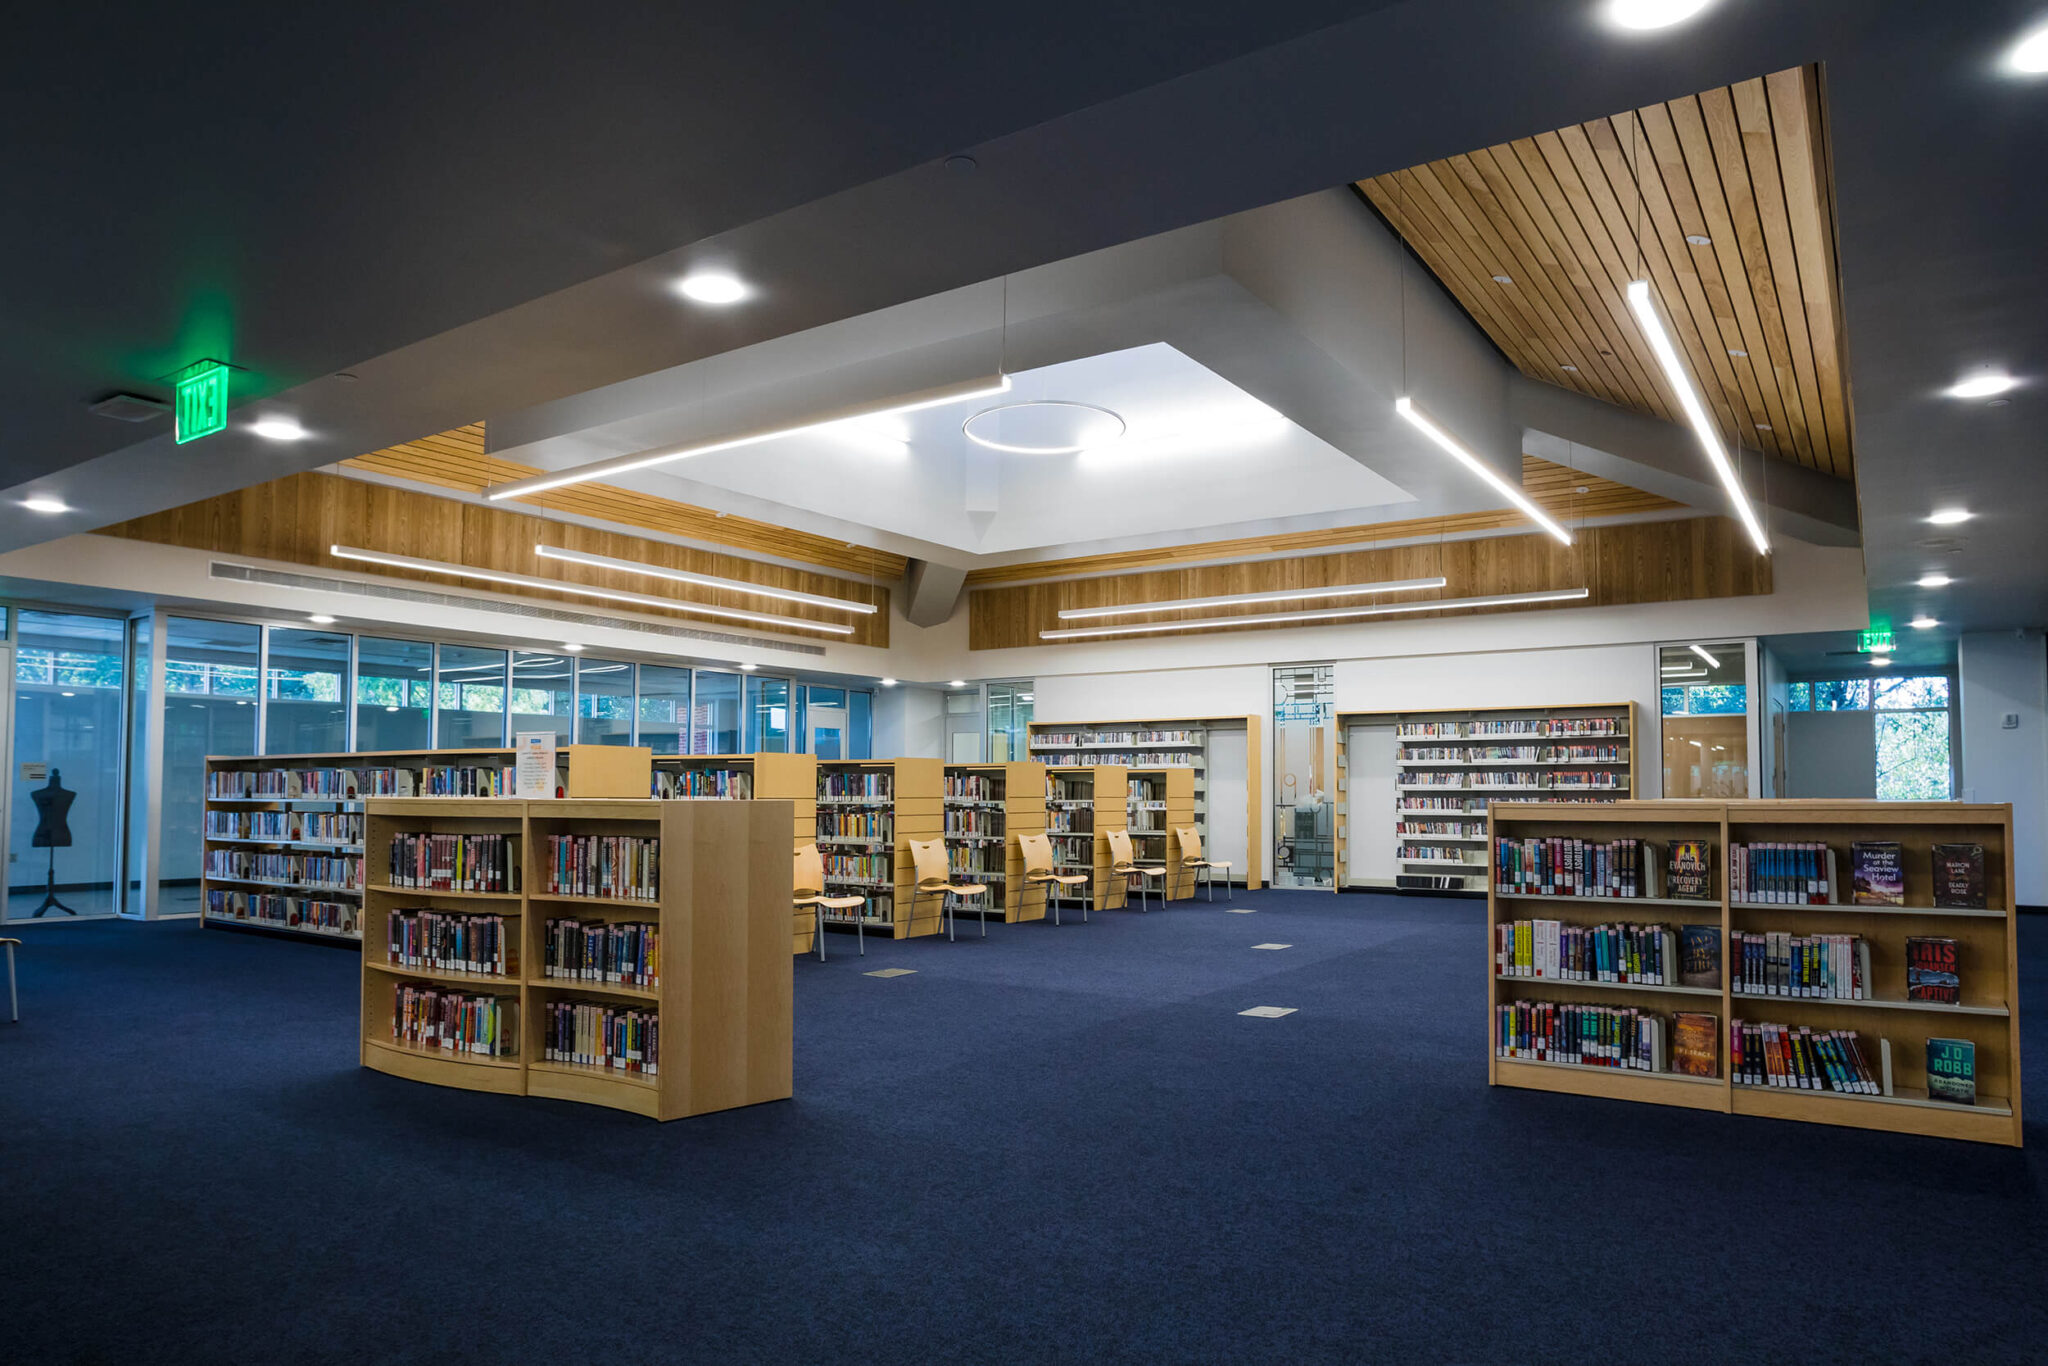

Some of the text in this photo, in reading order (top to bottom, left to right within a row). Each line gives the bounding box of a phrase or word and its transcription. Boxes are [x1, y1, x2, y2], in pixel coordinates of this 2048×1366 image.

[1863, 632, 1891, 649] EXIT
[1863, 852, 1896, 860] Murder
[1669, 861, 1706, 871] EVANOVICH
[1863, 864, 1900, 872] Seaview
[1673, 876, 1703, 885] RECOVERY
[1871, 872, 1896, 881] Hotel
[1678, 885, 1698, 893] AGENT
[1913, 944, 1956, 963] IRIS
[1934, 1059, 1972, 1076] ROBB
